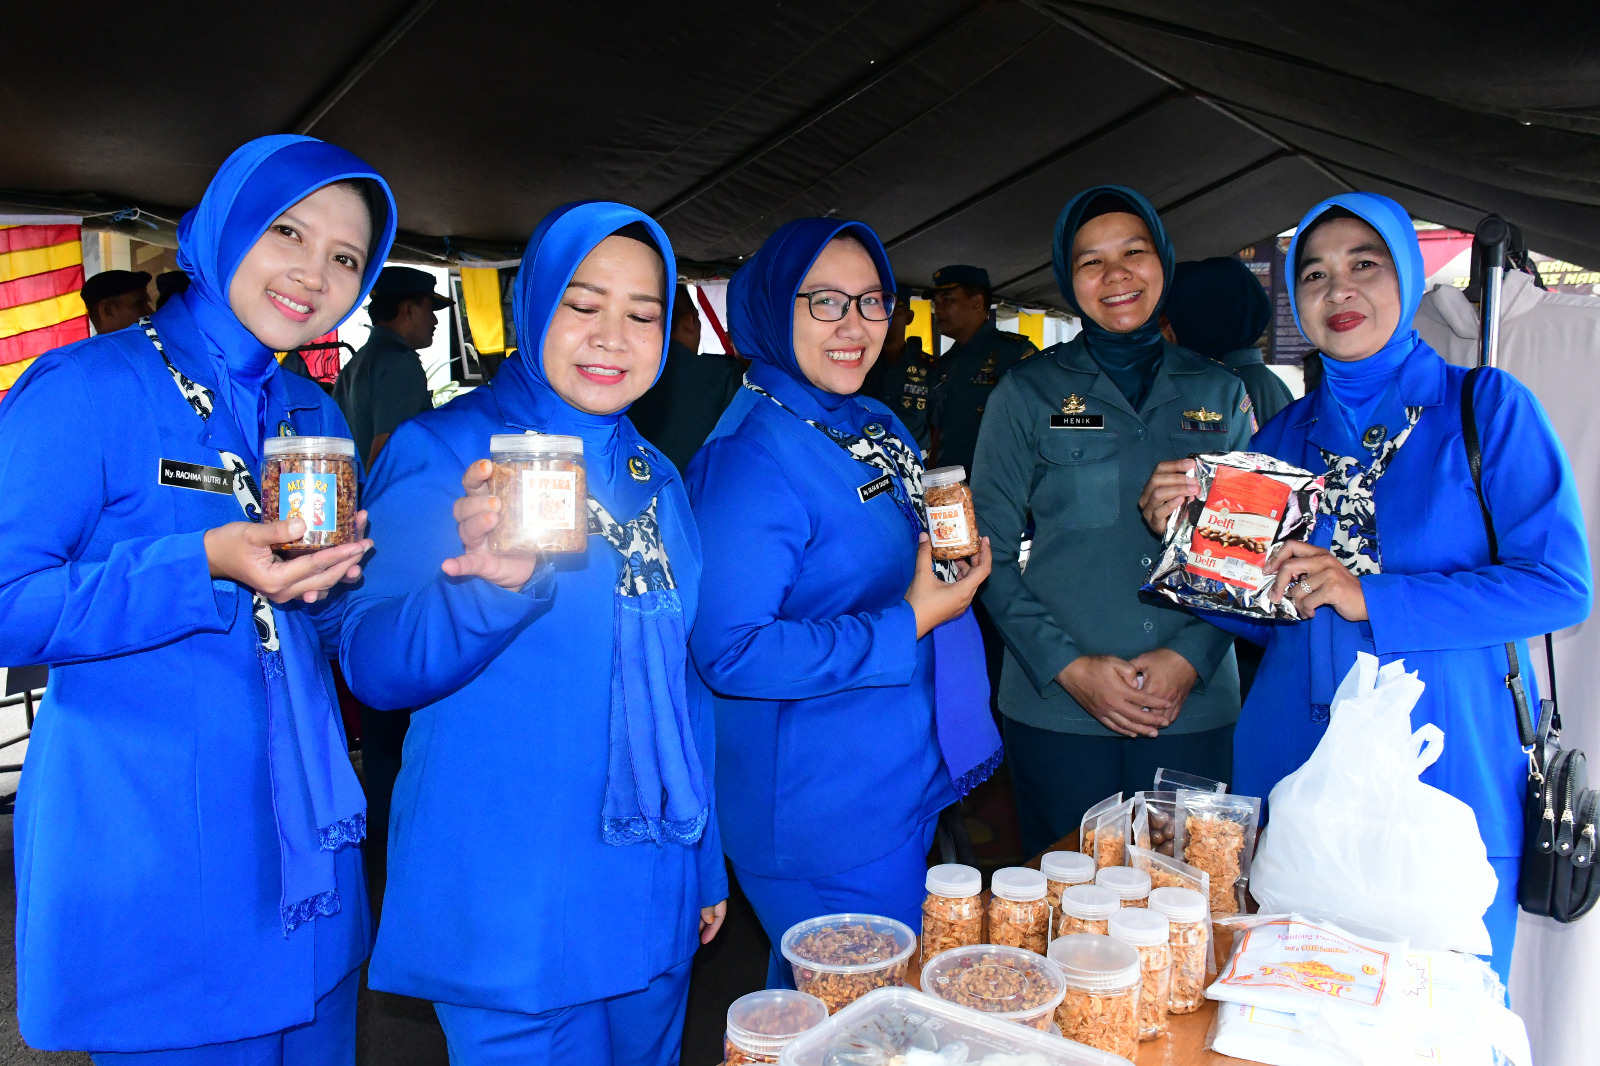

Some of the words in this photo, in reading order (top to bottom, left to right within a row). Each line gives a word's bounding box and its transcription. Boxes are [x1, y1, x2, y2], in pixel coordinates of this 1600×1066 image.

[1063, 417, 1091, 425] HENIK
[175, 470, 202, 482] RACHMA
[203, 474, 221, 485] NUTRI
[1207, 513, 1236, 530] Delfi
[1194, 554, 1217, 568] Delfi
